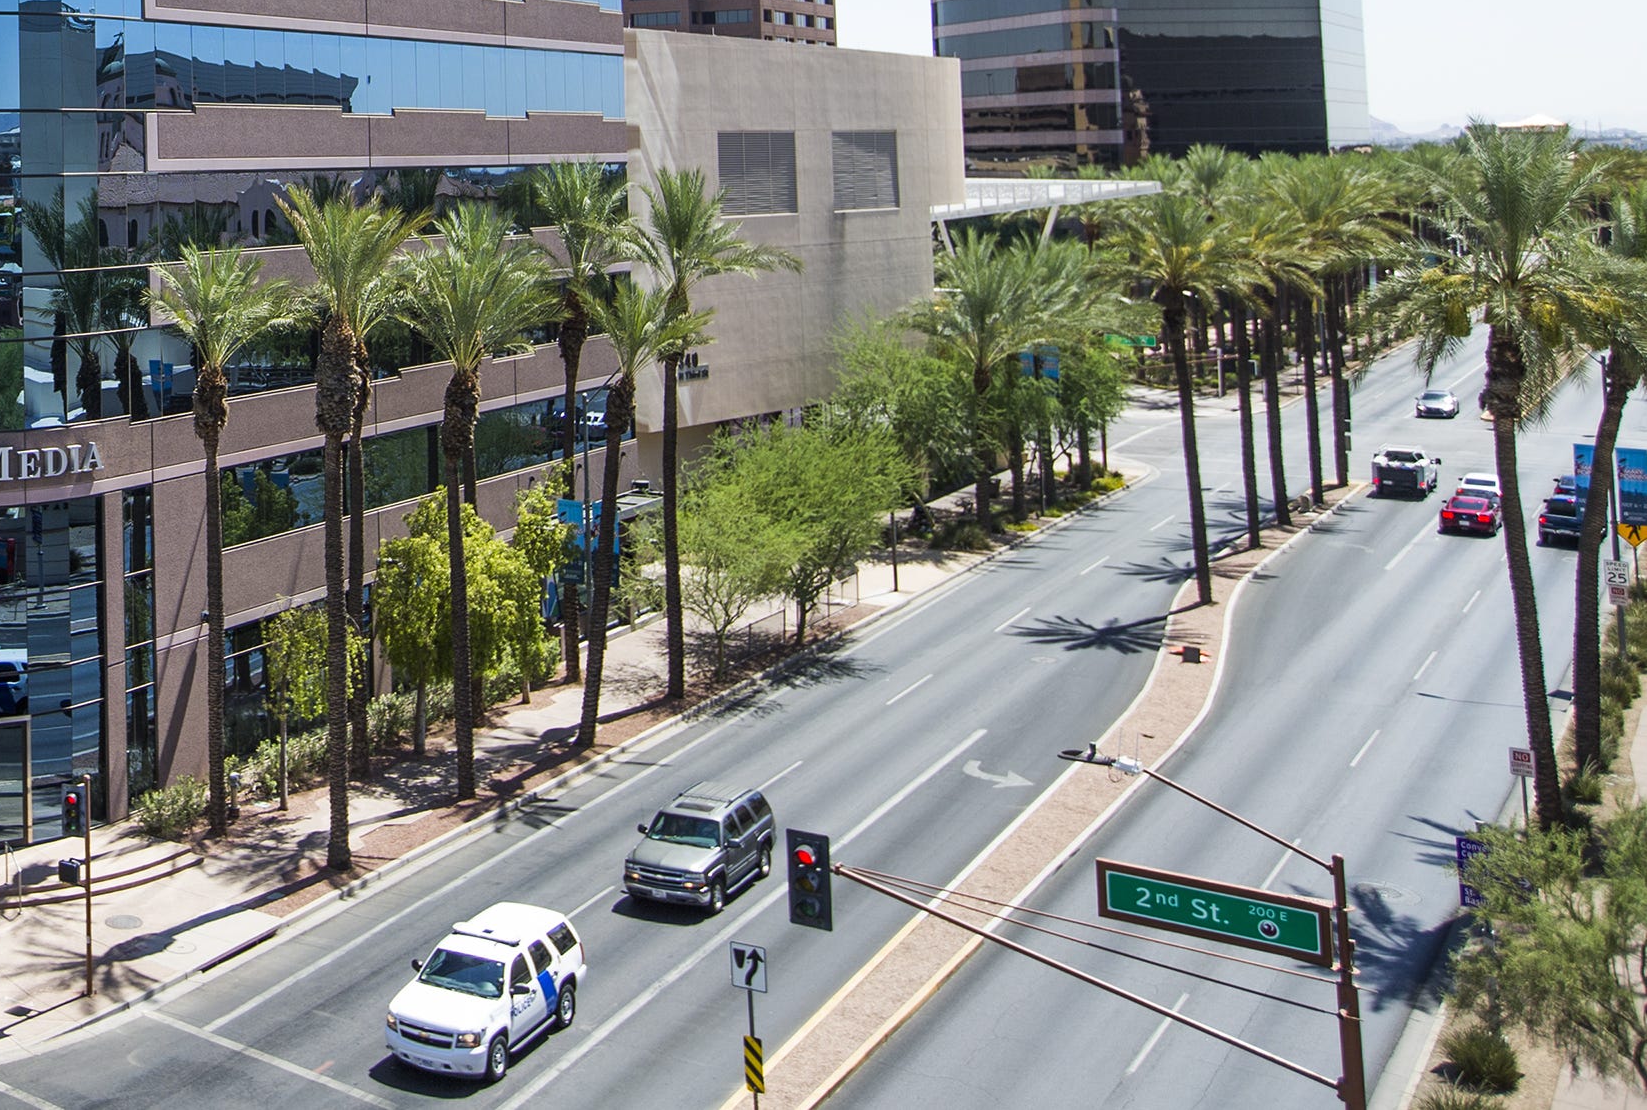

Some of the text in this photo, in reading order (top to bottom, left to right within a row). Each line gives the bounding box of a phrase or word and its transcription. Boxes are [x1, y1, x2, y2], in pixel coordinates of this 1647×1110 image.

[1608, 572, 1627, 583] 25
[1513, 752, 1529, 762] NO
[1135, 887, 1230, 925] 2nd St.
[1248, 905, 1288, 922] 200 E
